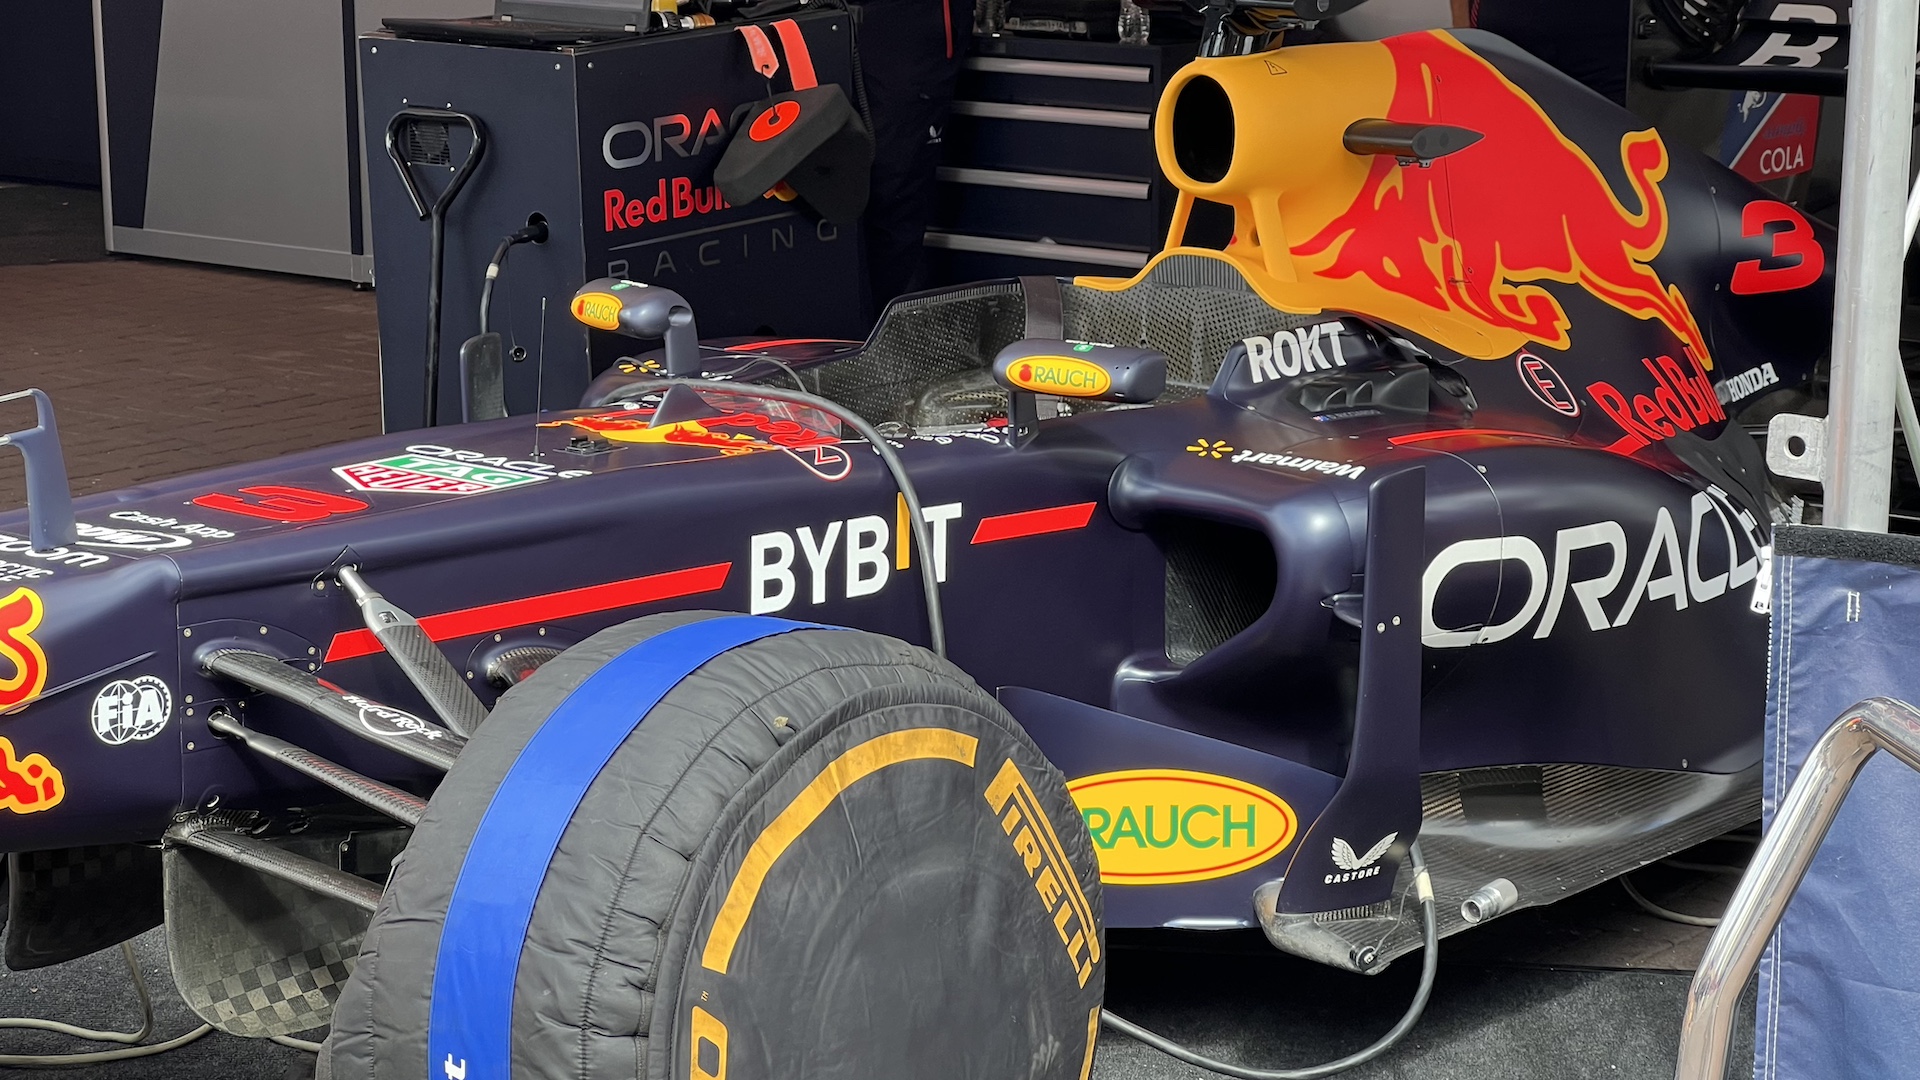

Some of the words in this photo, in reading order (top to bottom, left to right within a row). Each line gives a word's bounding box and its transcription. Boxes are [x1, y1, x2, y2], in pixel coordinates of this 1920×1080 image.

[1759, 143, 1804, 174] COLA
[672, 177, 731, 219] Bul
[1730, 200, 1825, 295] 3
[584, 299, 617, 323] RAUCH
[1242, 321, 1347, 383] ROKT
[1034, 365, 1097, 389] RAUCH
[1726, 362, 1779, 403] HONDA
[350, 465, 480, 492] HEUER
[405, 444, 593, 479] ORACLE
[405, 458, 523, 485] TAG
[1231, 449, 1366, 480] Walmart
[192, 485, 370, 522] 3
[109, 511, 178, 527] Cash
[171, 523, 235, 539] App
[750, 491, 963, 616] BYBIT
[1421, 483, 1766, 649] ORACLE
[342, 695, 397, 719] Hard
[391, 715, 443, 740] Rock
[1082, 804, 1256, 850] RAUCH
[984, 757, 1101, 990] PIRELLI
[1324, 866, 1381, 885] CASTORE
